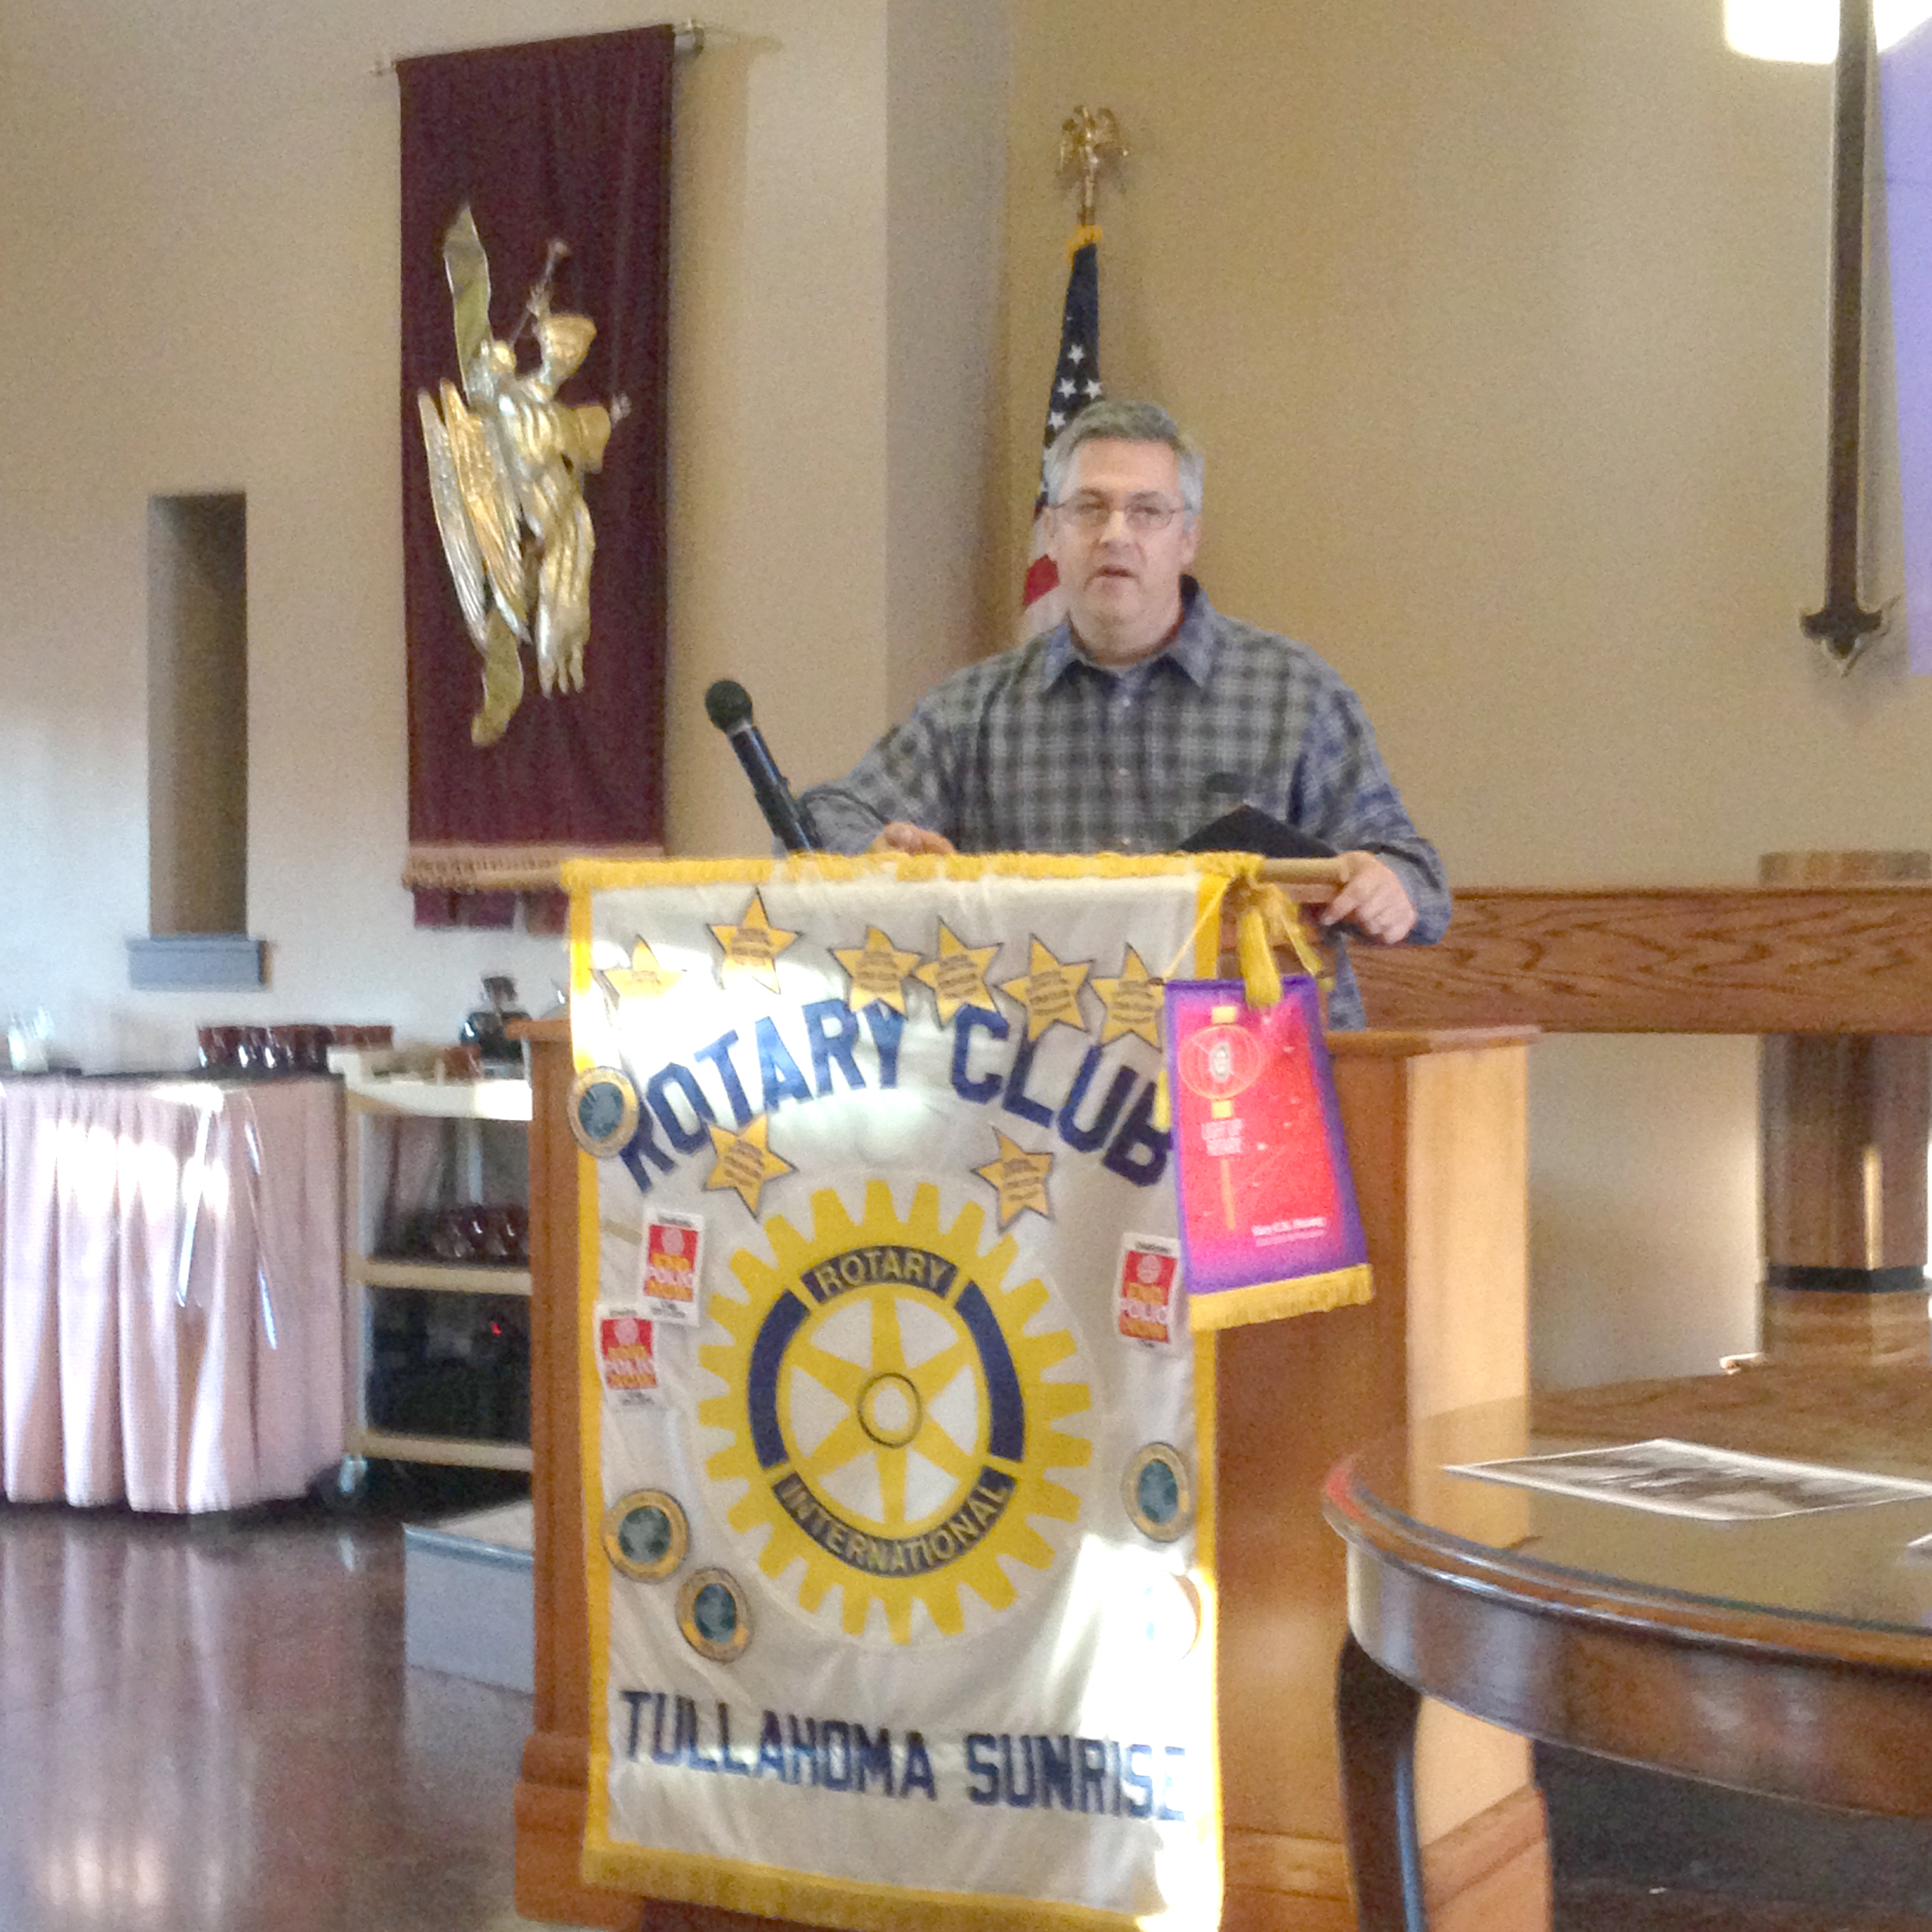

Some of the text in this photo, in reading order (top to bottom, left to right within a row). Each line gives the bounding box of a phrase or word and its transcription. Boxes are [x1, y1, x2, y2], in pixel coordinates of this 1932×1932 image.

[815, 1249, 949, 1297] ROTARY
[784, 1484, 1009, 1572] INTERNATIONAL
[620, 1690, 1187, 1822] TULLAHOMA SUNRISE
